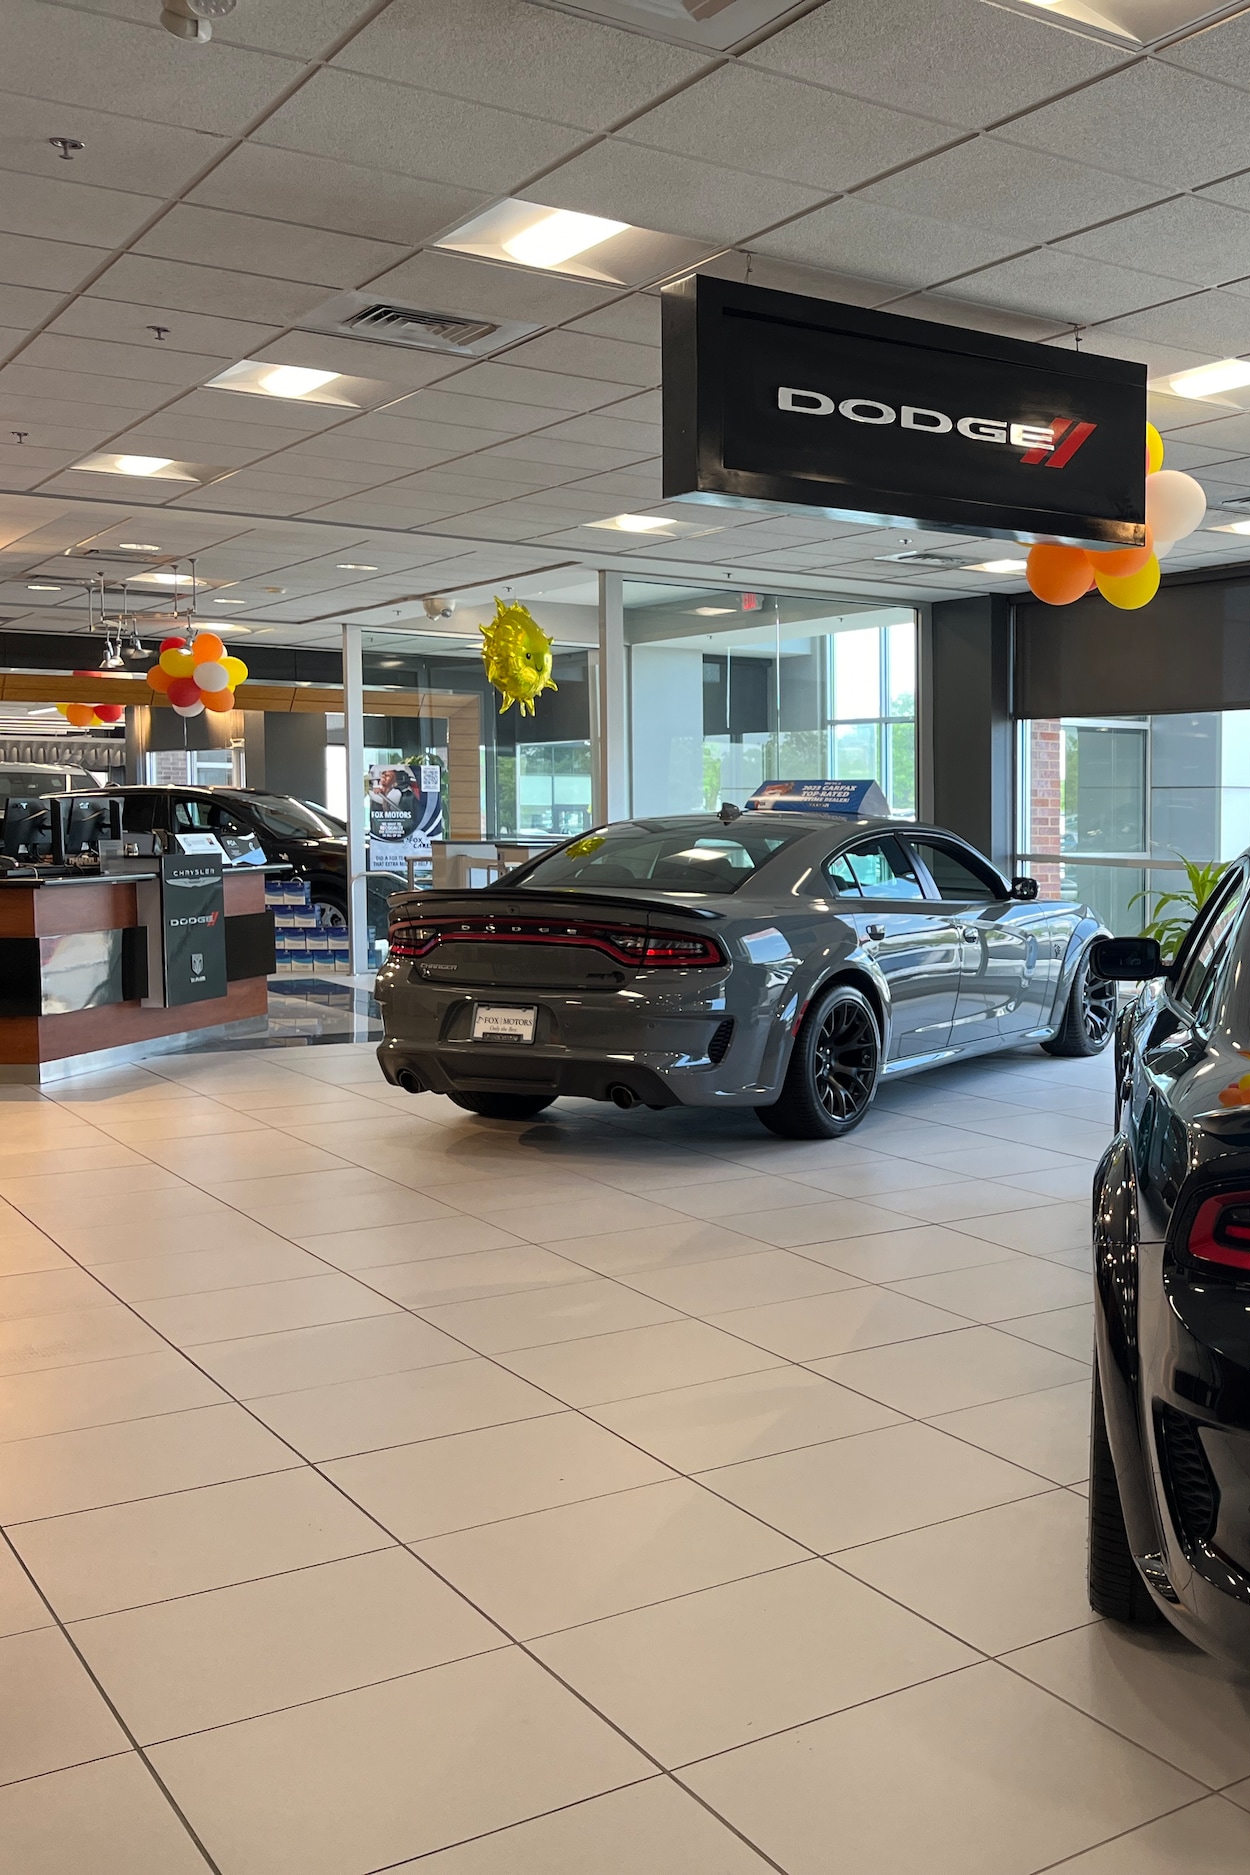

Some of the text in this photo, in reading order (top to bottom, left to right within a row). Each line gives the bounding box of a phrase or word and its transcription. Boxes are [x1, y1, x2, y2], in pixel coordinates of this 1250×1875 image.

[777, 386, 1055, 450] DODGE
[371, 811, 412, 819] FOX MOTORS
[173, 868, 215, 877] CHRYSLER
[170, 915, 213, 926] DODGE
[461, 924, 577, 935] DODGE
[420, 963, 458, 971] CHARGER
[484, 1016, 533, 1026] FOX MOTORS
